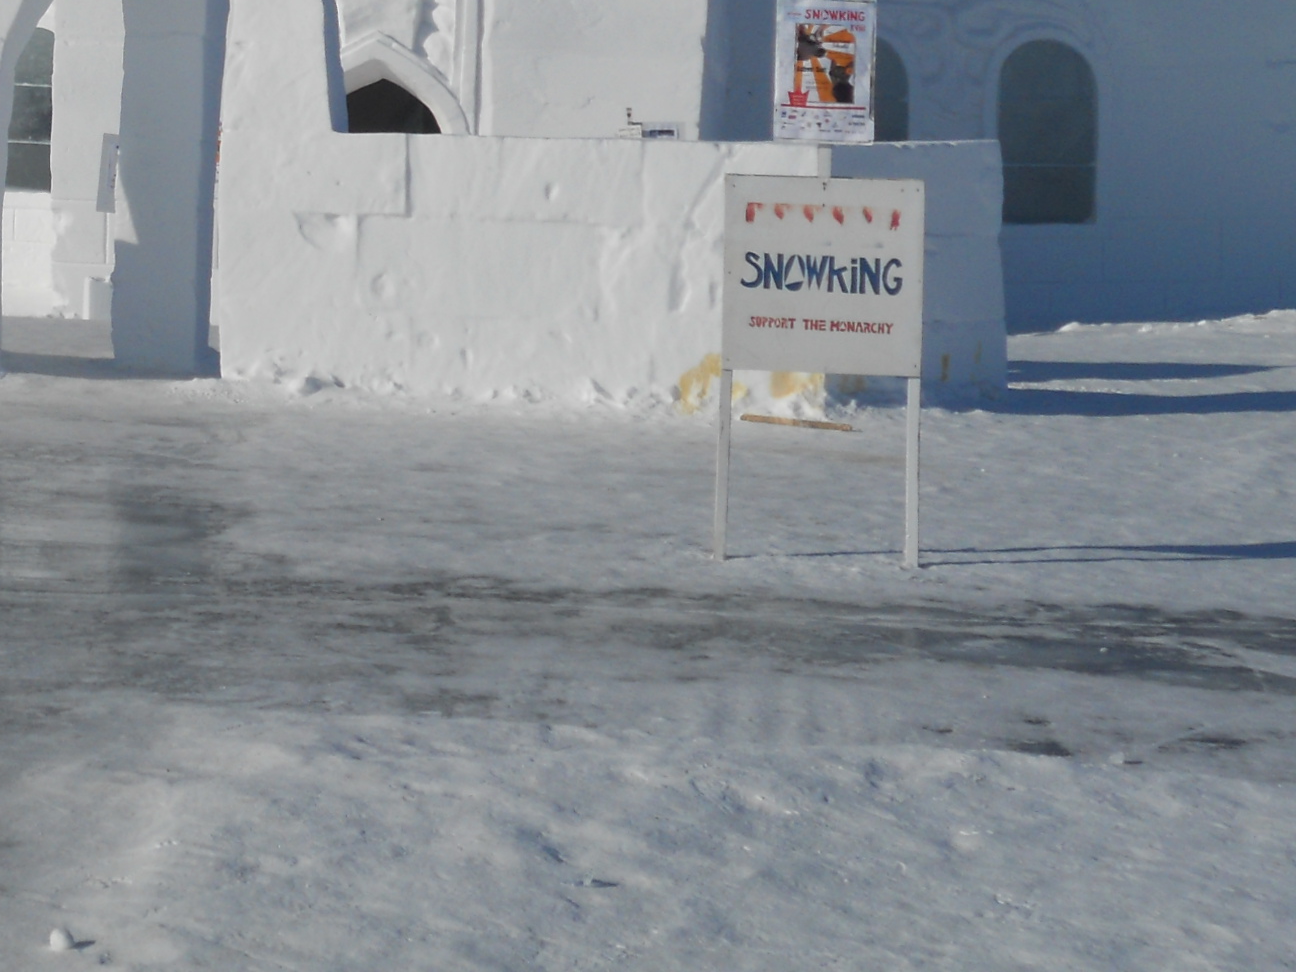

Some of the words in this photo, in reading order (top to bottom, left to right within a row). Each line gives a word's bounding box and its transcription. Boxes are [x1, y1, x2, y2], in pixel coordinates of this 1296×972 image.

[748, 316, 796, 329] SUPPORT
[802, 319, 826, 332] THE
[830, 320, 894, 335] MONARCHY
